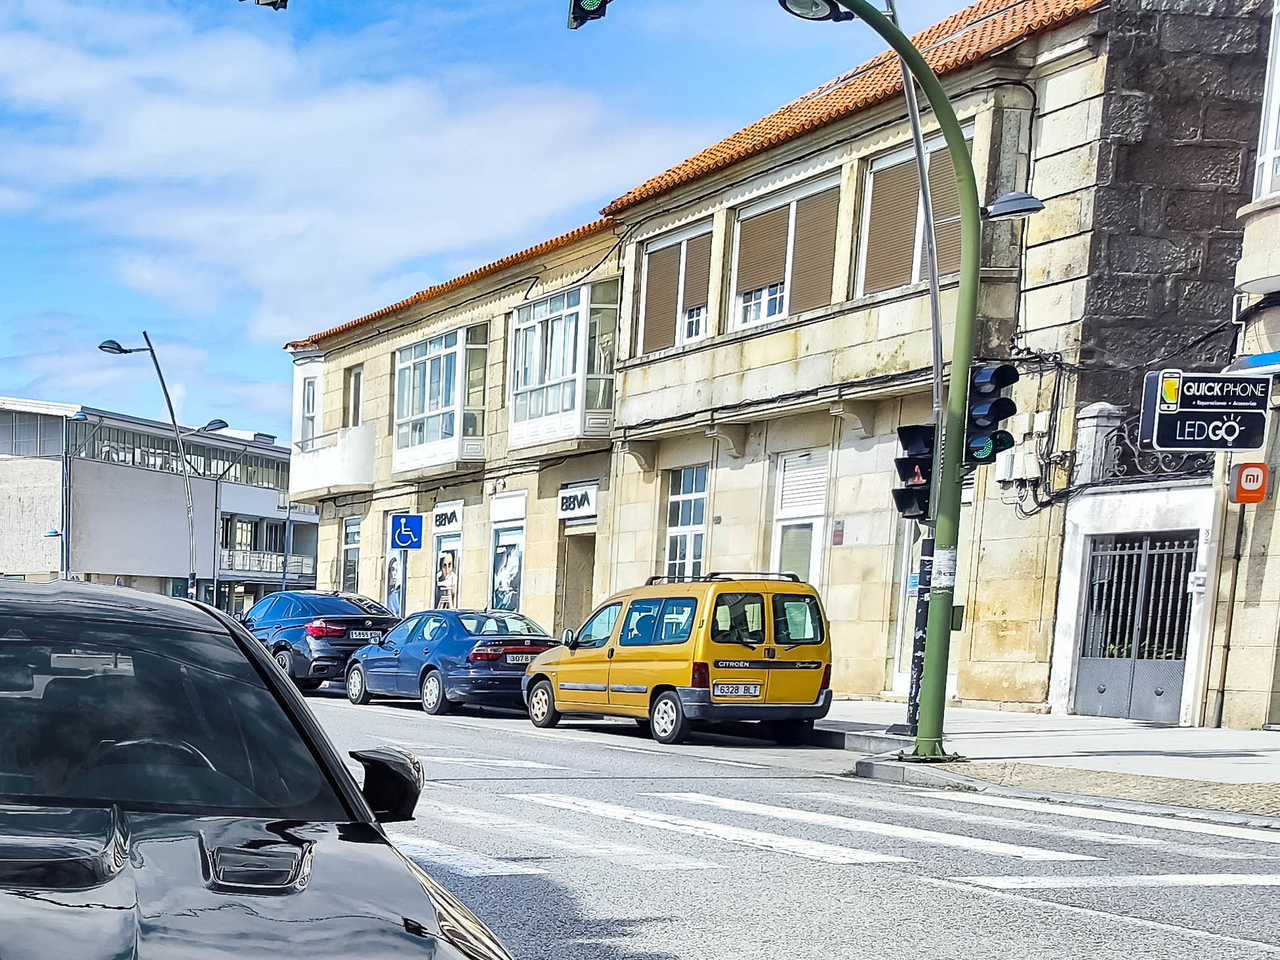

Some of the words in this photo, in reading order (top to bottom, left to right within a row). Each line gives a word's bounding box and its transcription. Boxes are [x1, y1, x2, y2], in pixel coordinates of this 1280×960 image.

[1183, 382, 1222, 396] QUICK
[1223, 383, 1266, 397] PHONE
[561, 491, 590, 512] BBVA
[435, 510, 458, 527] BBVA
[720, 685, 740, 694] 6328
[743, 685, 758, 694] BLT
